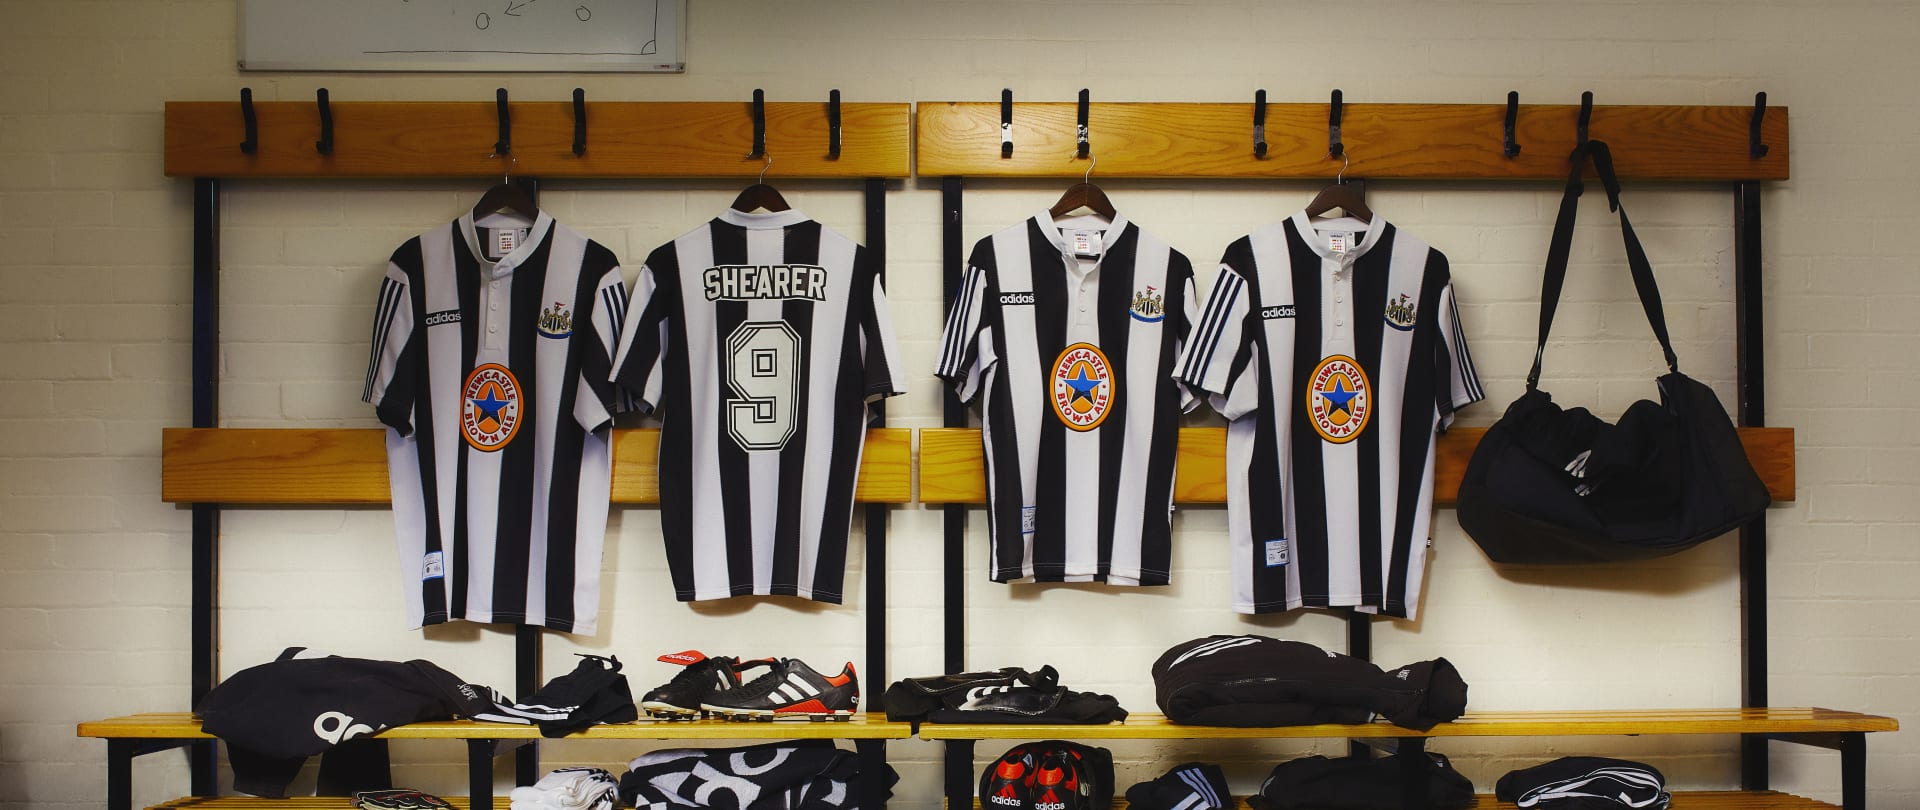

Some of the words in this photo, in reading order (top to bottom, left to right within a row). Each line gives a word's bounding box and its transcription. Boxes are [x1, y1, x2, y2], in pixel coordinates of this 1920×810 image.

[703, 265, 827, 301] SHEARER
[1000, 293, 1035, 304] adidas
[1262, 306, 1296, 318] adidas
[425, 312, 462, 325] adidas
[1058, 351, 1107, 379] NEWCASTLE
[1314, 363, 1364, 391] NEWCASTLE
[467, 371, 516, 400] NEWCASTLE
[726, 319, 802, 452] 9
[1058, 393, 1093, 422] BROWN
[1094, 394, 1107, 414] ALE
[1314, 405, 1351, 434] BROWN
[1352, 406, 1365, 426] ALE
[465, 413, 499, 442] BROWN
[501, 416, 515, 436] ALE
[991, 795, 1021, 807] adidas
[1034, 802, 1065, 810] adidas
